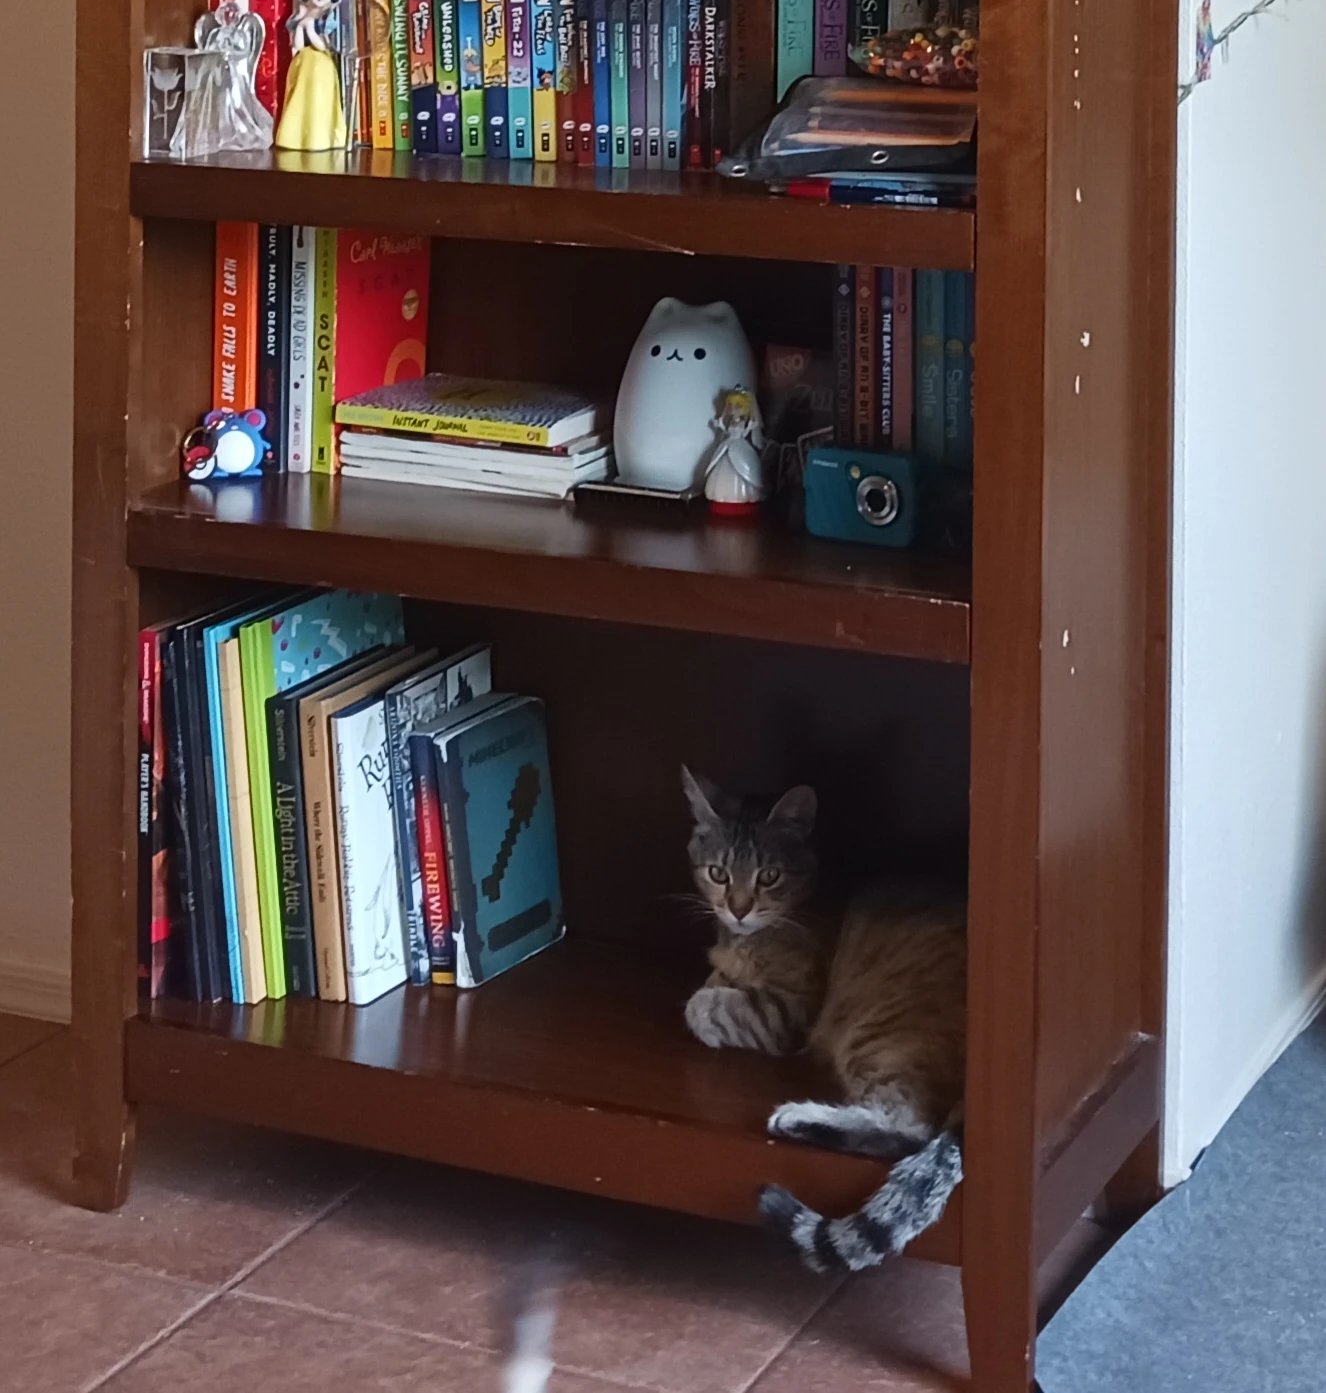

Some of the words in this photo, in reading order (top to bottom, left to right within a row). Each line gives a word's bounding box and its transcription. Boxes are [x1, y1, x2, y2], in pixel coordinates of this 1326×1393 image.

[688, 40, 702, 66] FIRE
[704, 7, 717, 90] DARKSTALKER
[823, 23, 845, 61] FIRE
[377, 83, 388, 107] DICE
[396, 59, 409, 102] SUNNY
[268, 224, 277, 259] RULY,
[350, 238, 378, 264] Carl
[223, 257, 238, 296] EARTH
[266, 264, 276, 306] MADLY,
[293, 261, 307, 303] MISSING
[223, 302, 236, 317] TO
[292, 304, 306, 332] DEAD
[859, 306, 869, 342] DIARY
[882, 313, 891, 332] THE
[222, 324, 236, 359] FALLS
[267, 311, 276, 356] DEADLY
[317, 314, 331, 392] SCAT
[769, 353, 805, 379] UNO
[859, 346, 869, 361] OF
[221, 361, 236, 403] SNAKE
[920, 363, 940, 417] Smile
[945, 368, 963, 438] Sisters
[392, 415, 430, 429] INSTANT
[433, 420, 468, 433] JOURNAL
[881, 408, 891, 435] CLUB
[274, 708, 286, 761] Silverstein
[307, 715, 317, 758] Silverstein
[389, 706, 399, 744] ARIZONA
[140, 753, 150, 789] PLAYER'S
[276, 781, 295, 795] A
[140, 790, 149, 834] HANDBOOK
[420, 774, 429, 816] KENNETH
[275, 796, 297, 834] Light
[313, 801, 321, 827] Where
[423, 817, 432, 843] OPPEL
[314, 829, 323, 843] the
[282, 853, 299, 877] the
[315, 844, 326, 880] Sidewalk
[283, 879, 302, 915] Attic
[424, 851, 446, 949] FIREWING
